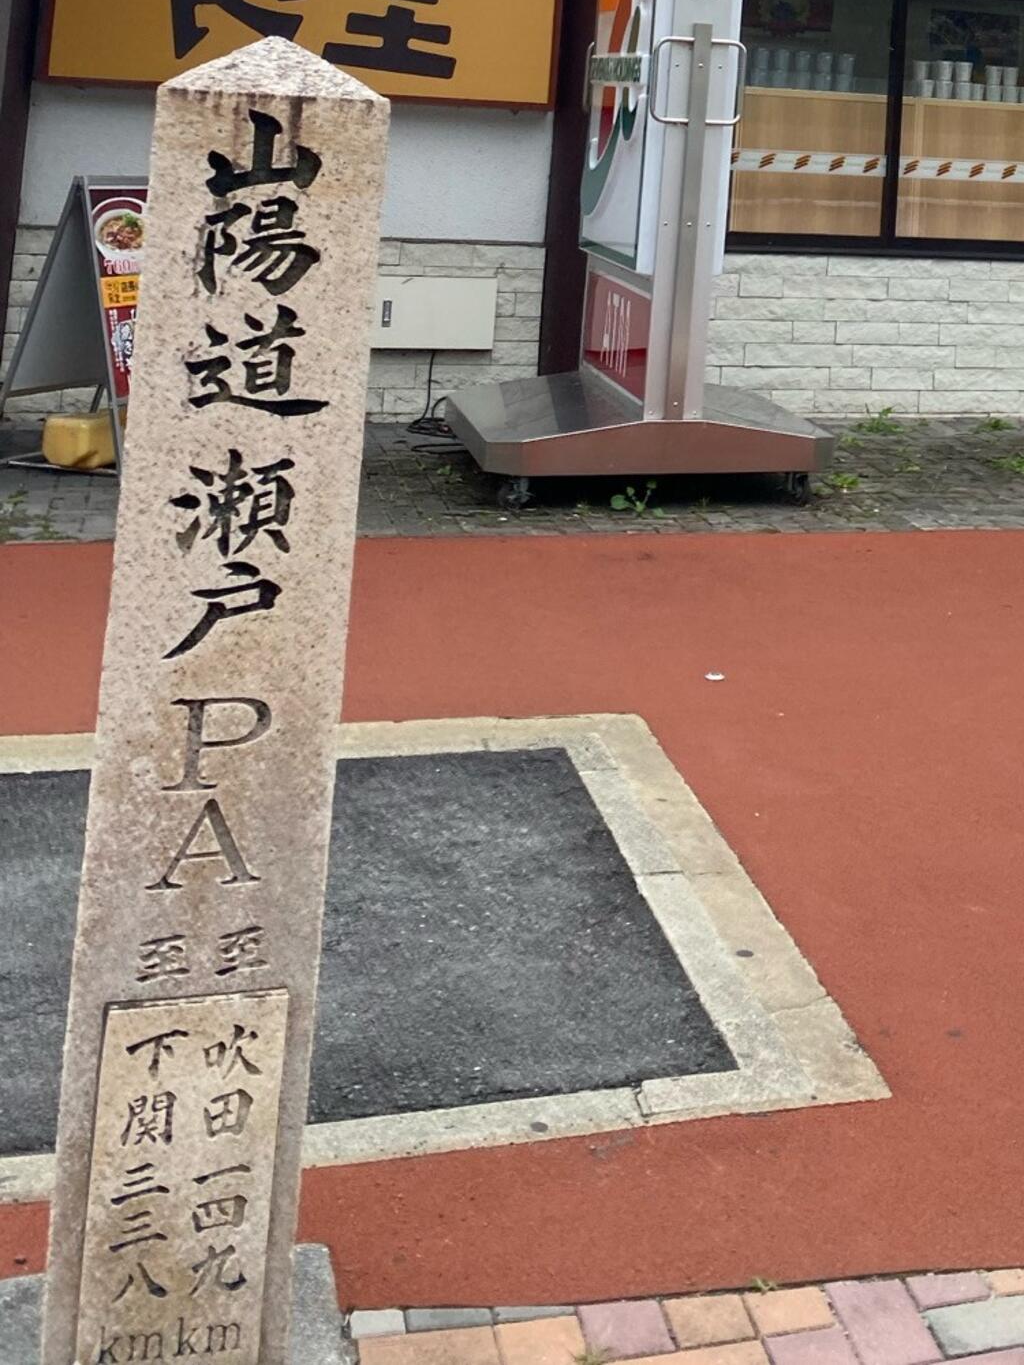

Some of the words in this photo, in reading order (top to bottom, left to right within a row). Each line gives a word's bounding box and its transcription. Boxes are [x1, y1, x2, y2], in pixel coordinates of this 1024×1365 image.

[144, 695, 273, 891] PA
[97, 1325, 164, 1365] km
[173, 1316, 241, 1357] km
